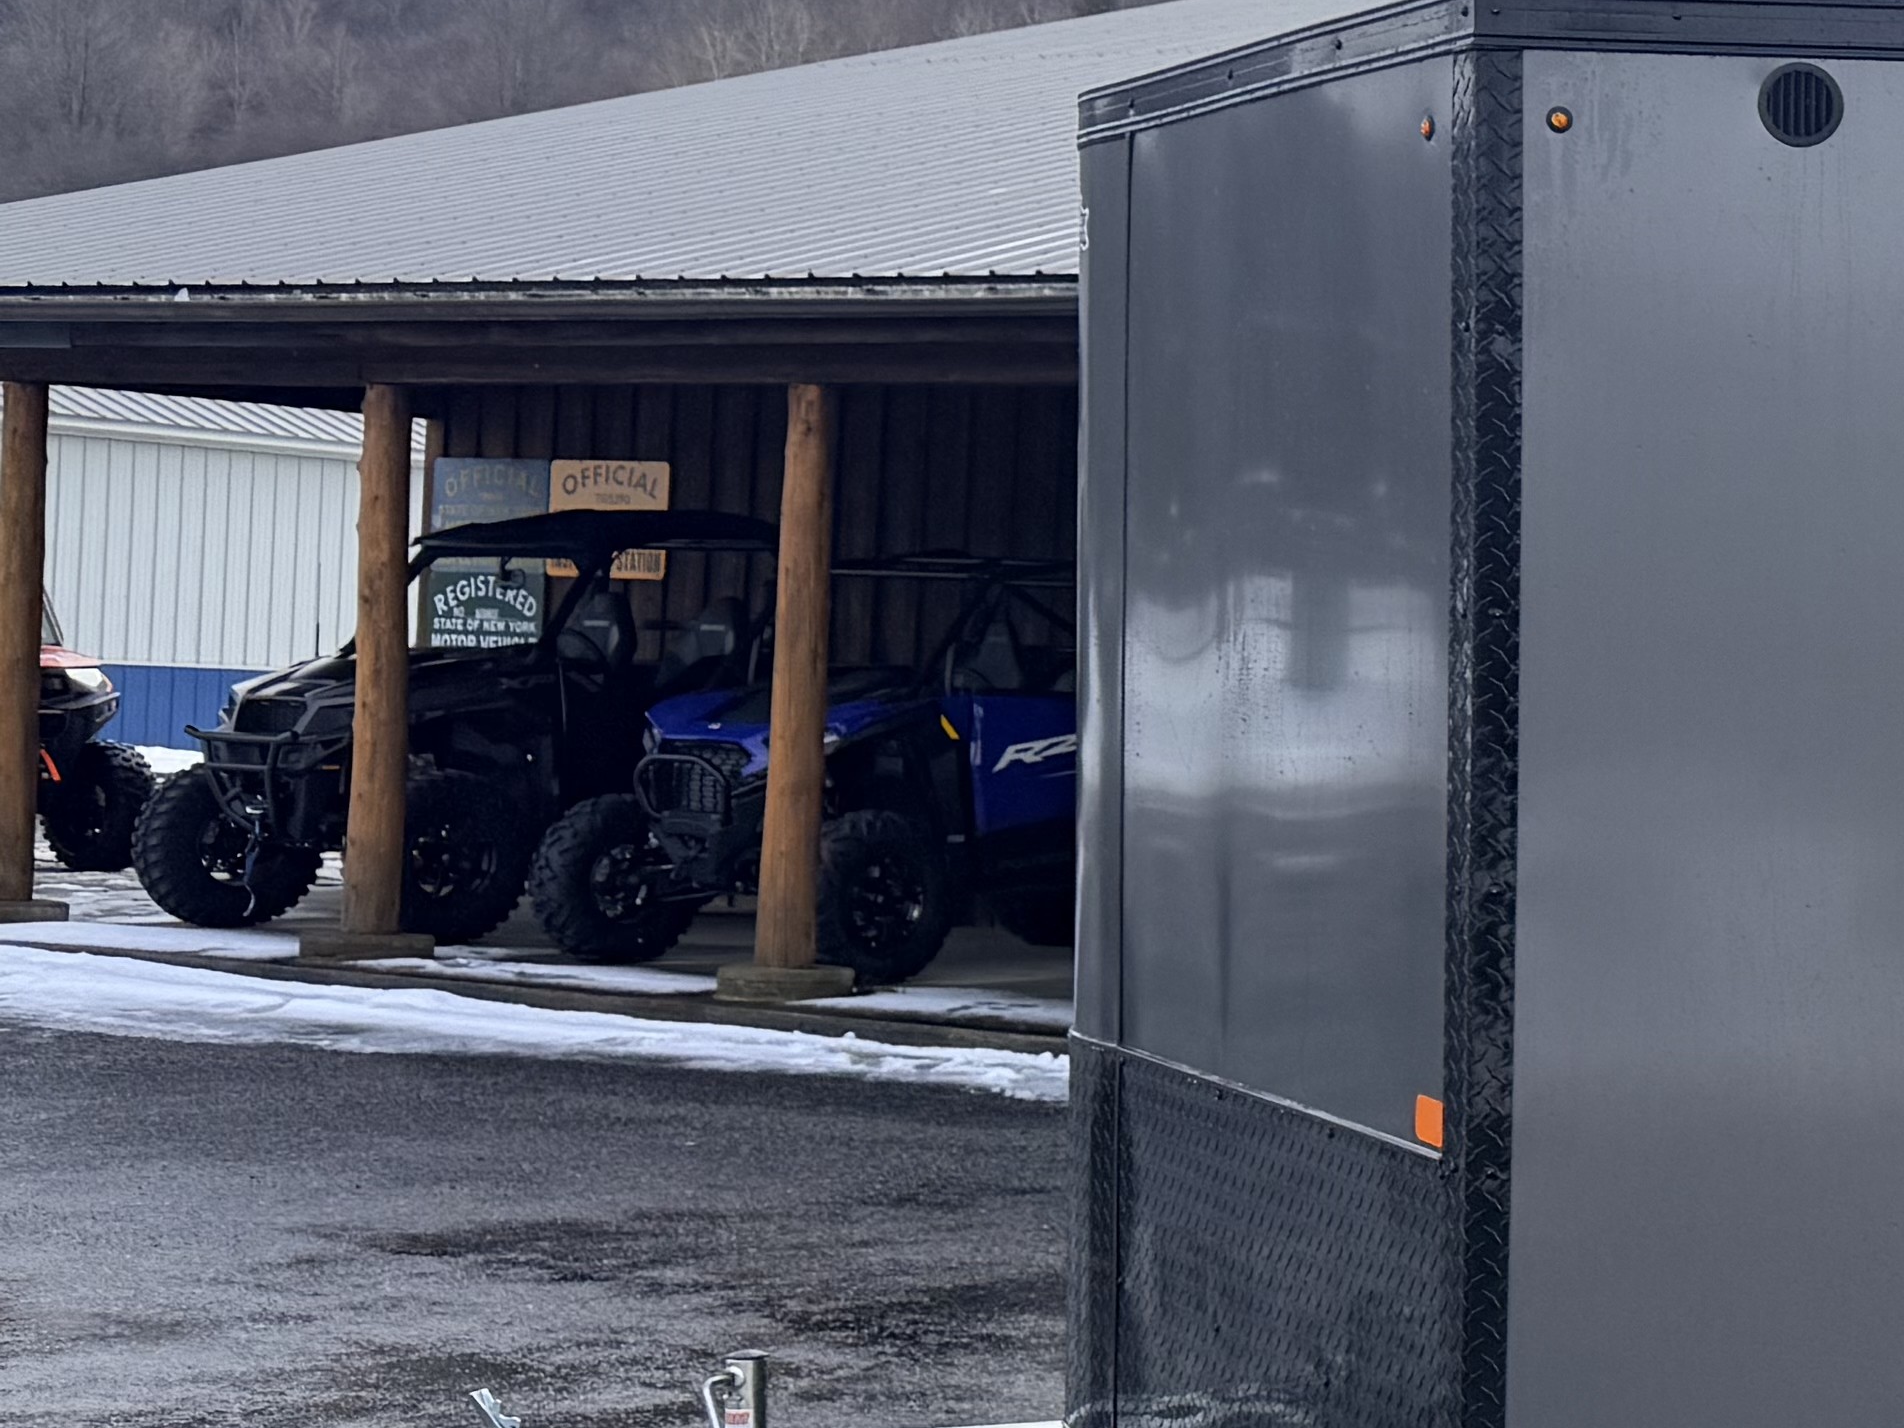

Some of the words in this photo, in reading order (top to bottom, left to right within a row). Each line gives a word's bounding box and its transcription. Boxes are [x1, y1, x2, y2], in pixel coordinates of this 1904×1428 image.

[562, 464, 658, 501] OFFICIAL
[433, 575, 537, 617] REGISTERED
[433, 618, 464, 631] STATE
[466, 619, 481, 631] OF
[482, 621, 506, 632] NEW
[508, 621, 537, 633] YORK
[991, 733, 1077, 774] RZ
